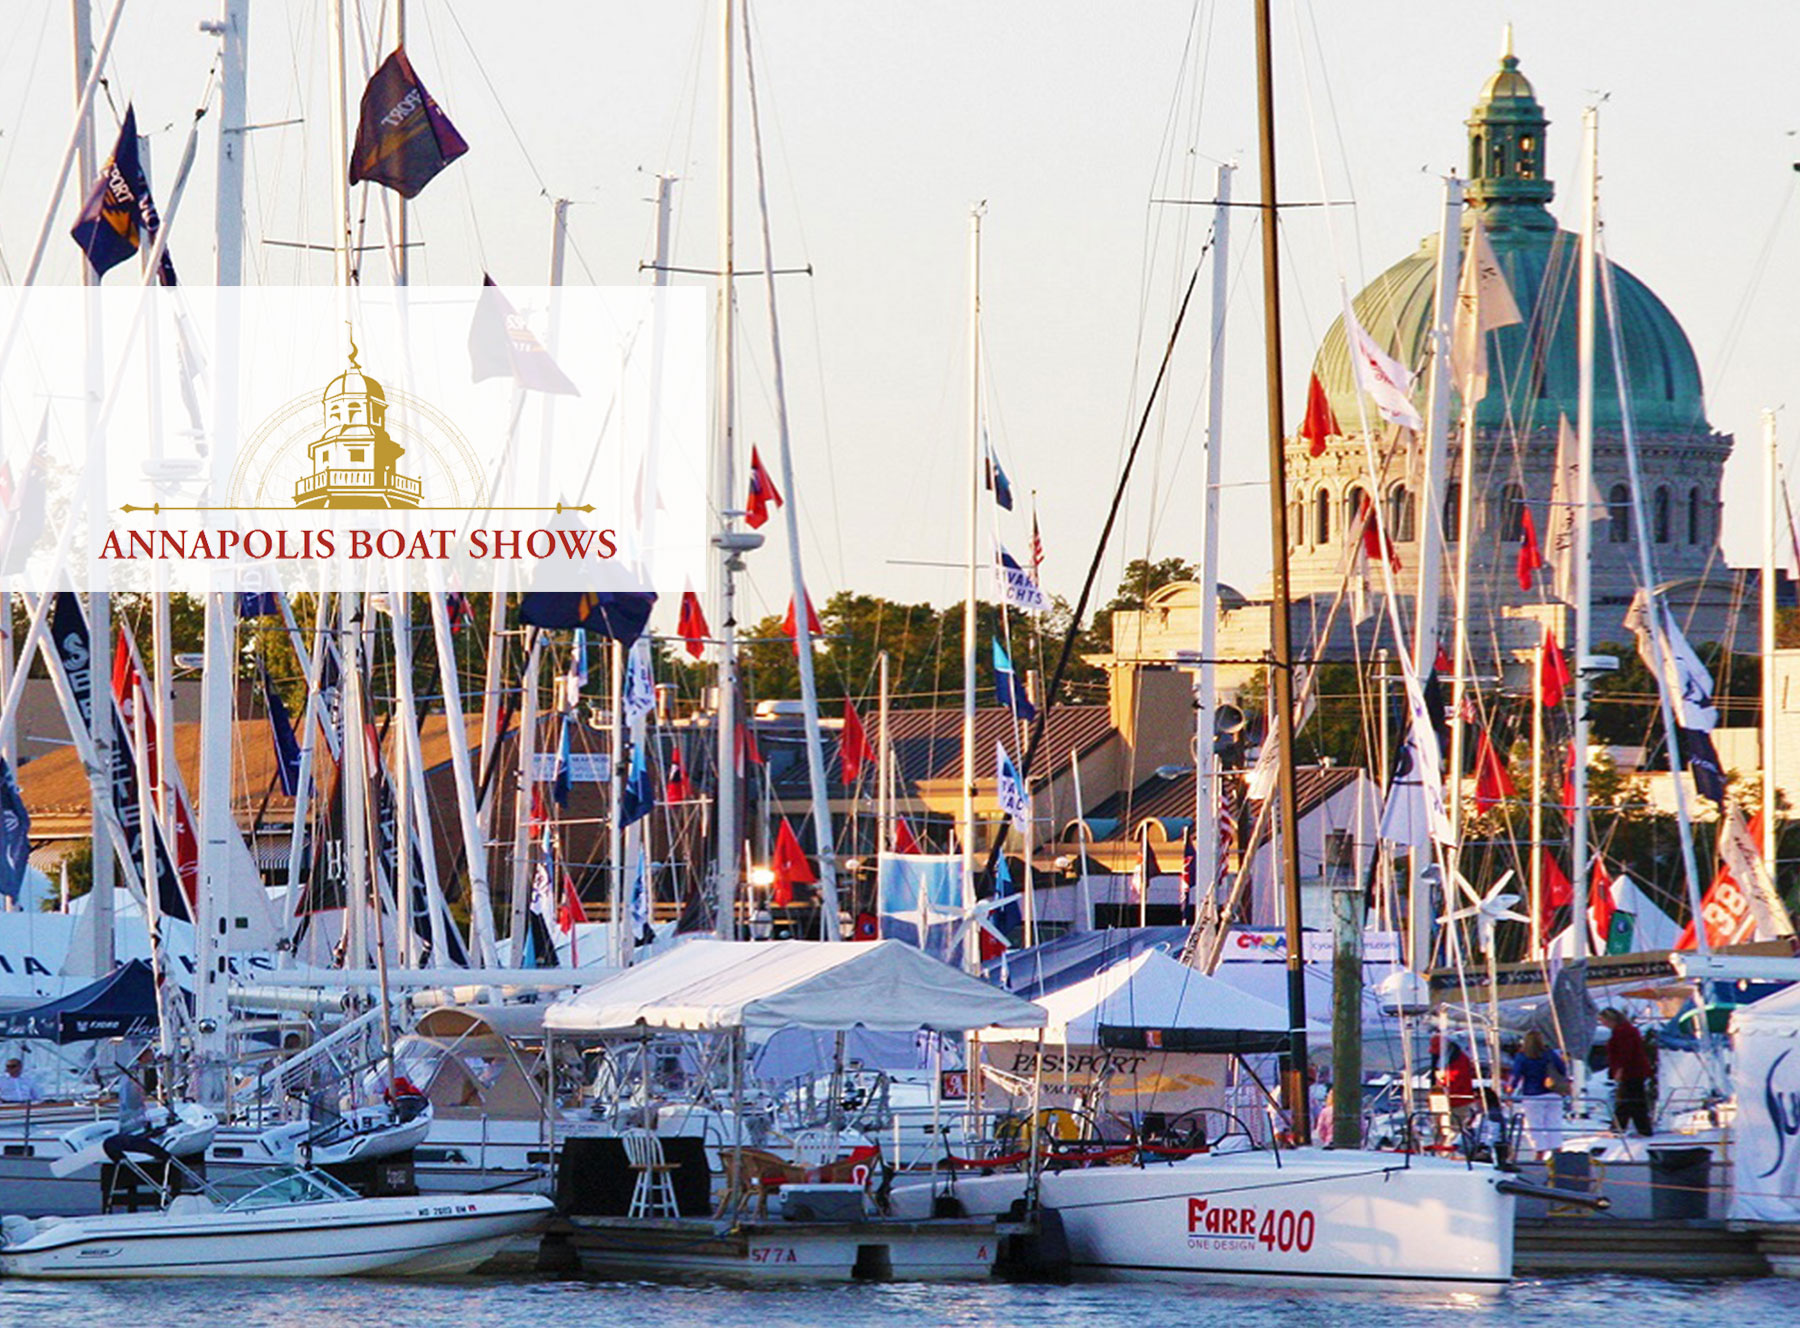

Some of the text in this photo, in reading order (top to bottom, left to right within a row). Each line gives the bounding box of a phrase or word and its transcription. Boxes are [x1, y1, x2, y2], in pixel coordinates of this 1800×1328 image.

[1011, 1053, 1146, 1074] PASSPORT
[1258, 1209, 1315, 1253] 400
[976, 1245, 989, 1260] A
[1187, 1239, 1256, 1251] ONE DESIGN
